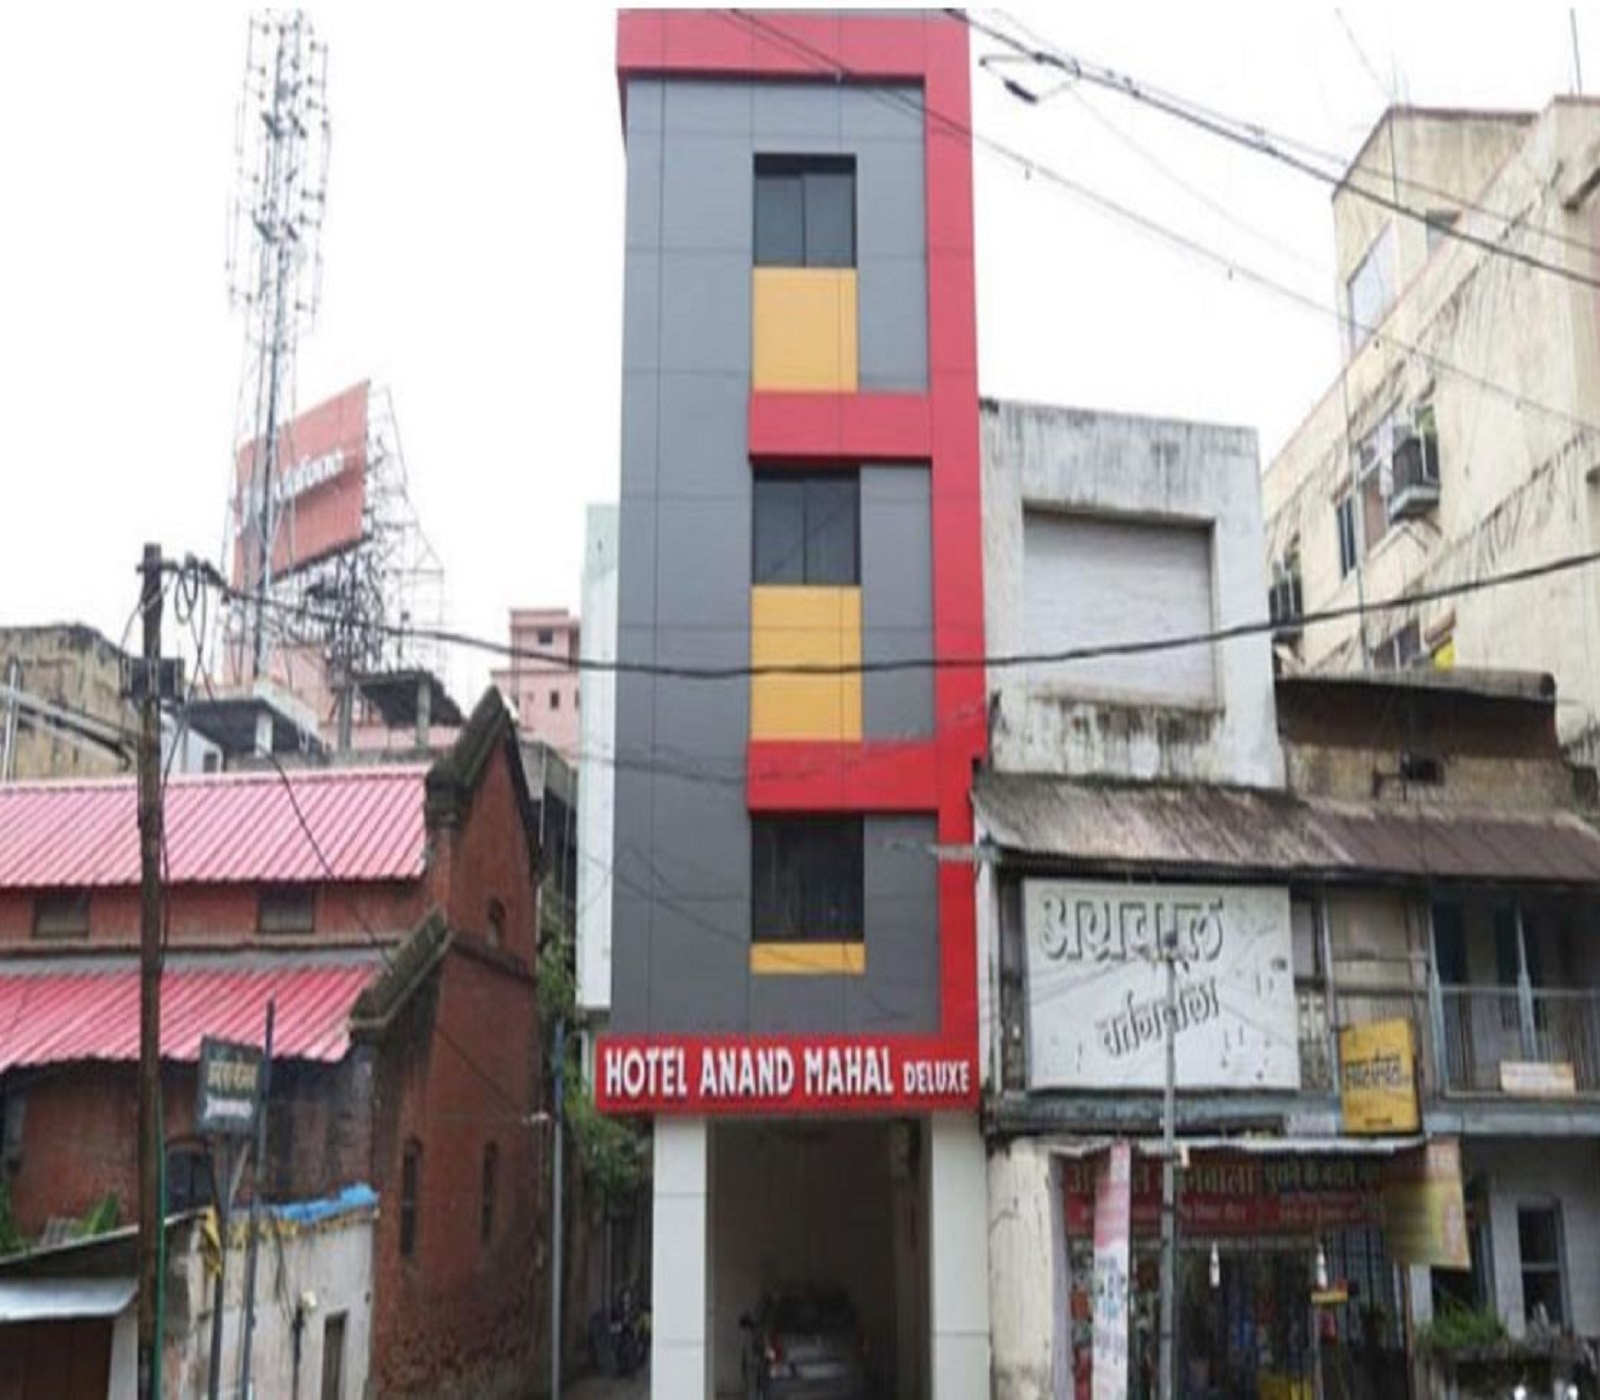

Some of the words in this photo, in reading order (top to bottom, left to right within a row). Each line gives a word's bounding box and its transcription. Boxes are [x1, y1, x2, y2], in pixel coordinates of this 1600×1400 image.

[605, 1046, 687, 1097] HOTEL
[699, 1047, 795, 1096] ANAND
[804, 1047, 894, 1095] MAHAL
[903, 1060, 970, 1094] DELUXE
